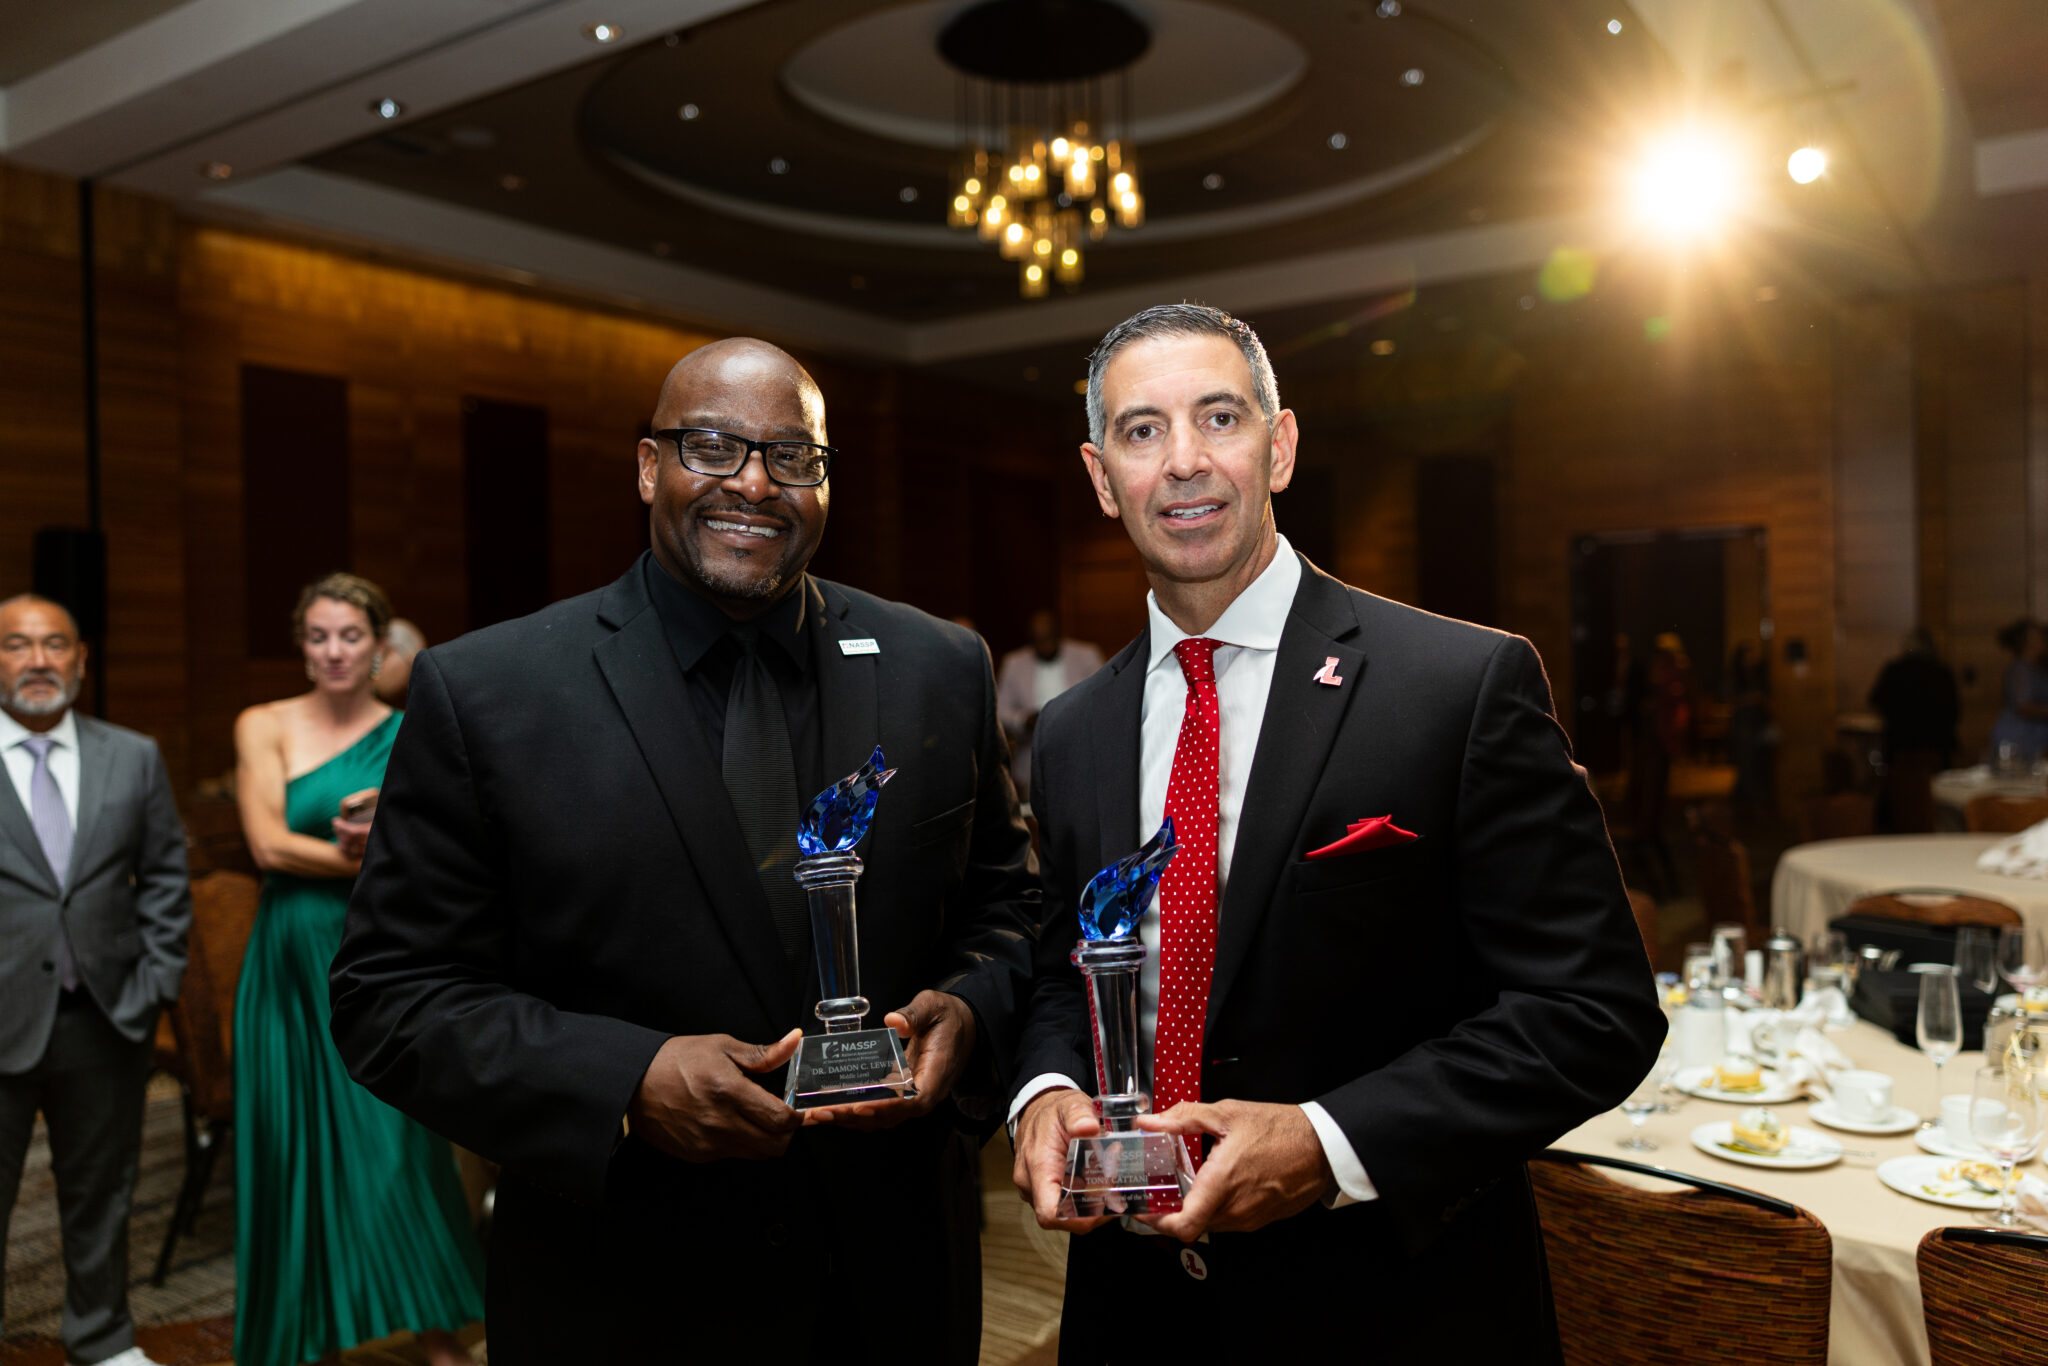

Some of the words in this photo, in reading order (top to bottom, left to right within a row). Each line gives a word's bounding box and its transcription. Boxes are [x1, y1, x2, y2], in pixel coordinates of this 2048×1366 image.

[841, 1040, 877, 1052] NASSP
[812, 1067, 826, 1076] DR.
[828, 1064, 859, 1074] DAMON
[1086, 1176, 1109, 1185] TONY
